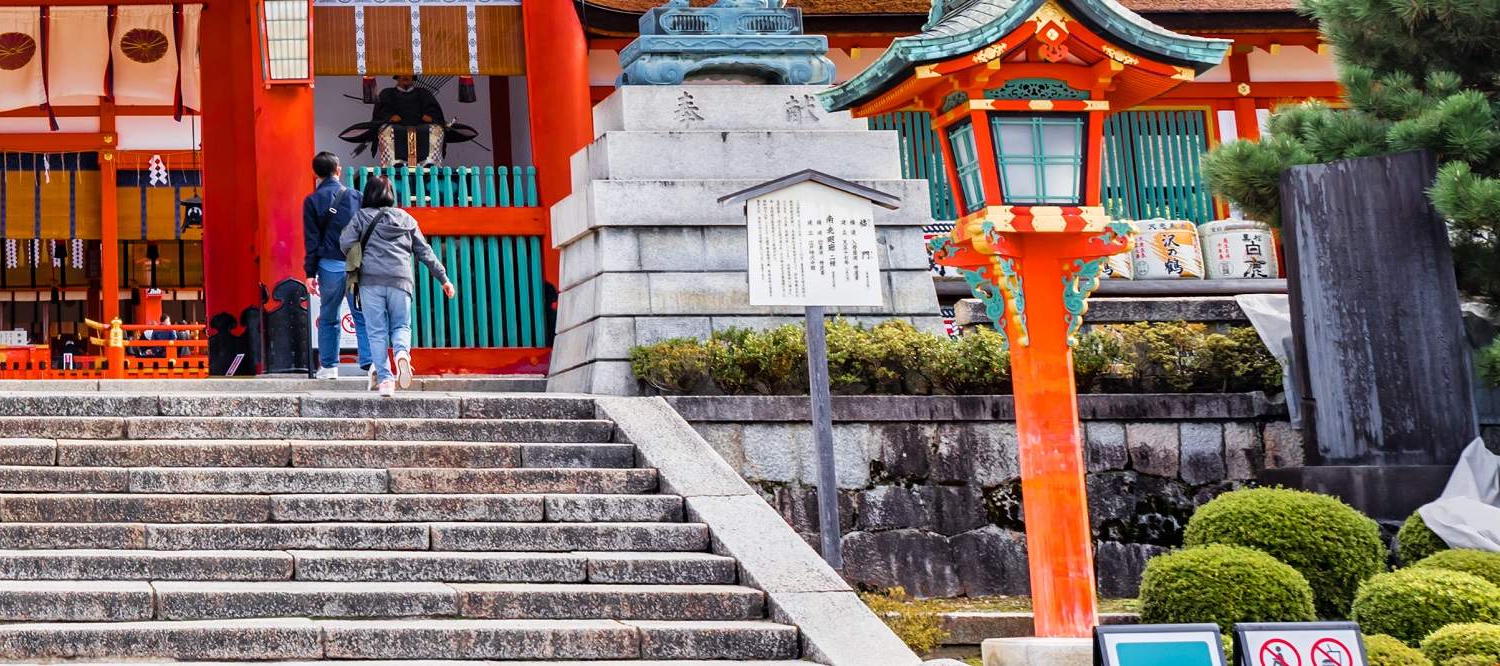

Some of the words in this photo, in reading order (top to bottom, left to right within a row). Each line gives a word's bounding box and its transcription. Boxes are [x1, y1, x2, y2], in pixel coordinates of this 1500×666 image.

[1161, 234, 1183, 275] 沢の鶴
[1243, 241, 1268, 278] 白鹿
